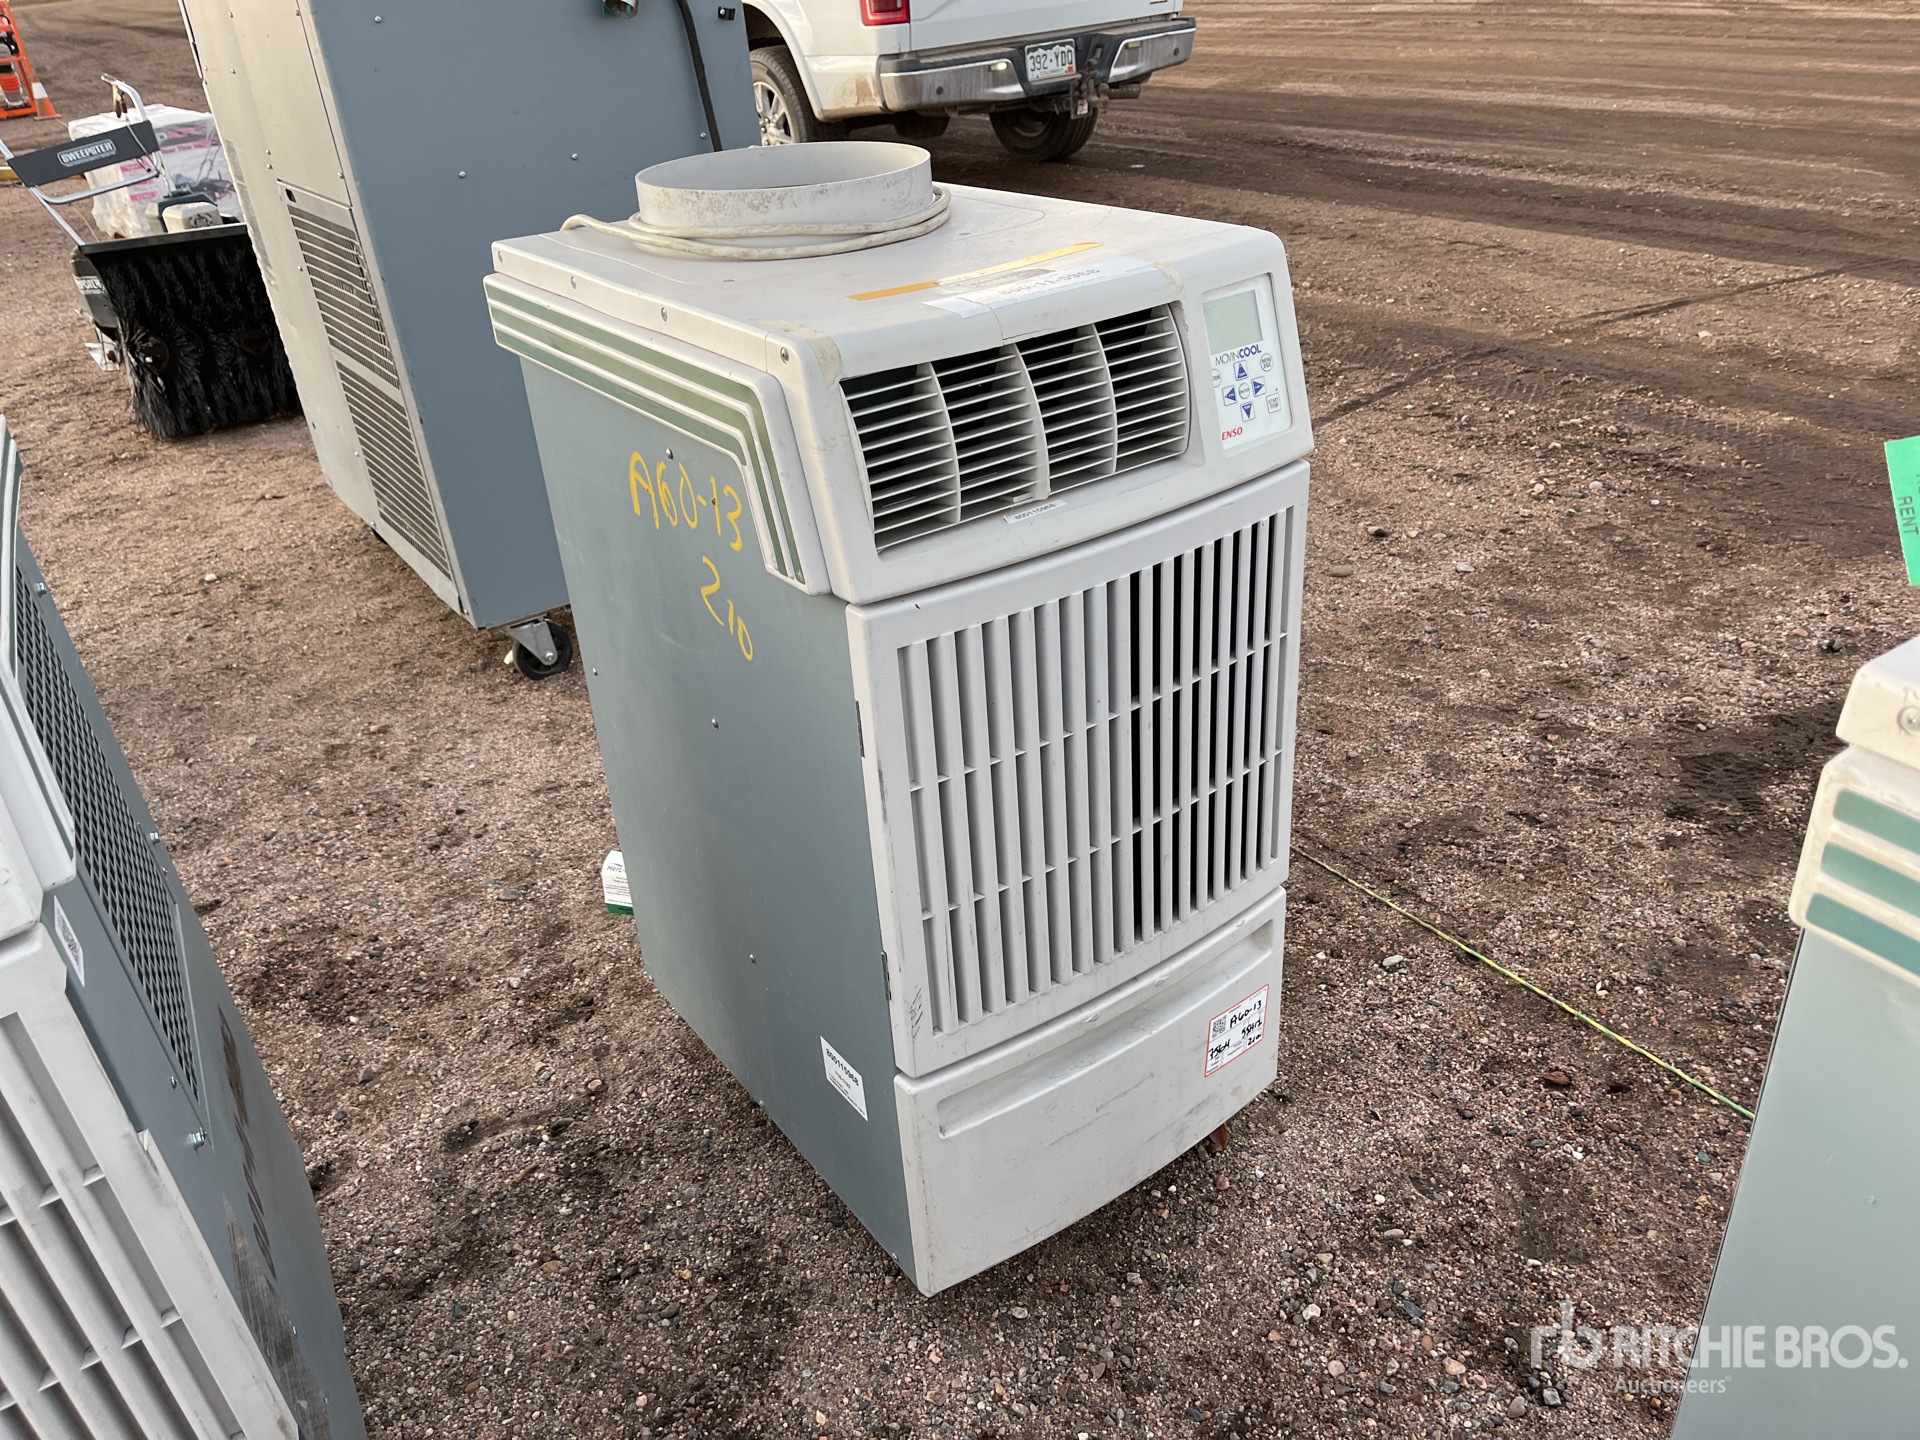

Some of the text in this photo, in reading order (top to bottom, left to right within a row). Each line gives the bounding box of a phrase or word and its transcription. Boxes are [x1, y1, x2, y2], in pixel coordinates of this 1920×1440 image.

[1215, 344, 1262, 366] MOVINCOOL
[629, 450, 743, 551] A60-13
[1899, 496, 1919, 535] RENT
[606, 865, 626, 874] Herc
